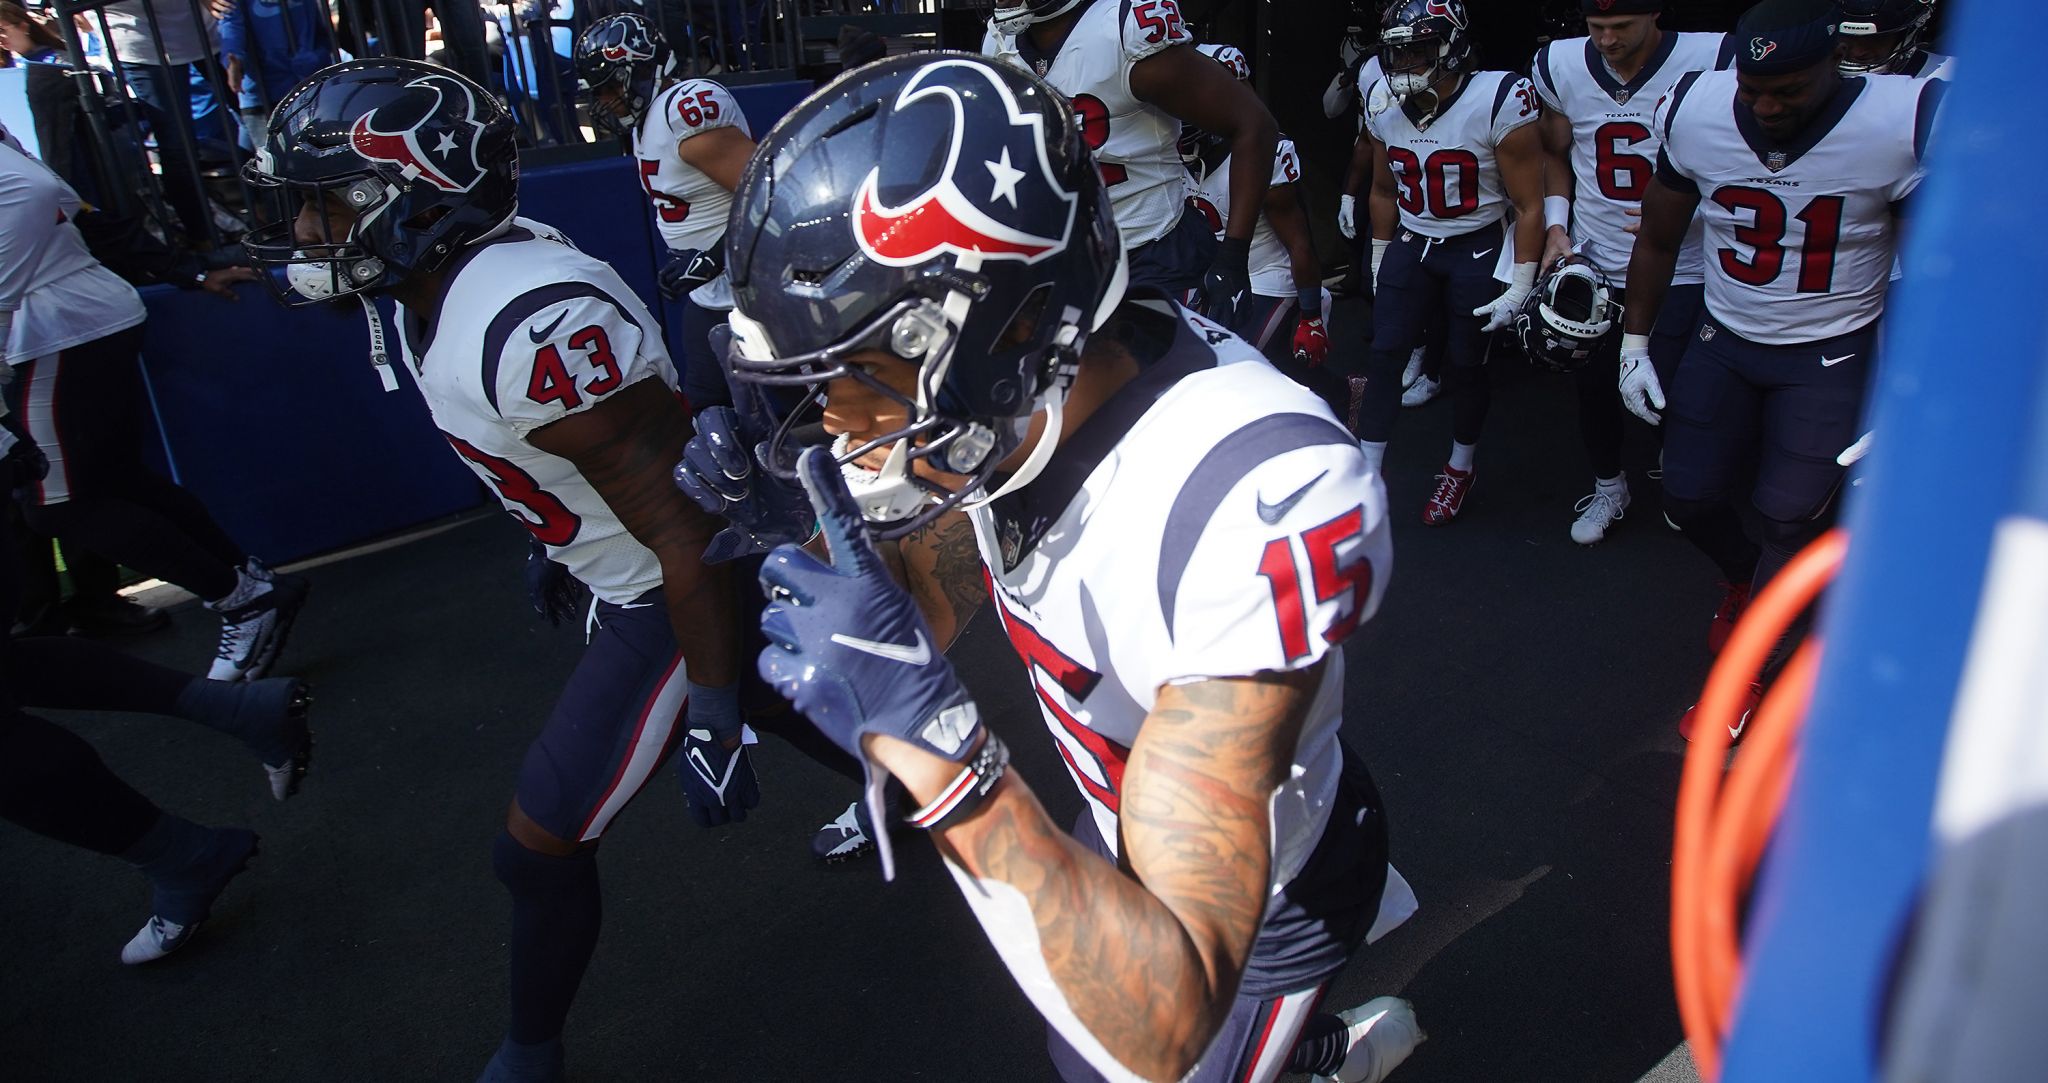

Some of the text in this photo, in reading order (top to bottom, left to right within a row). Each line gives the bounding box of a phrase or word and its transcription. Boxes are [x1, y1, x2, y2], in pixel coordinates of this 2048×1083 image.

[1133, 1, 1184, 43] 52
[677, 90, 730, 127] 65
[1515, 84, 1544, 117] 30
[1387, 145, 1480, 219] 30
[1594, 121, 1654, 202] 6
[1746, 176, 1800, 188] TEXANS
[1710, 184, 1846, 293] 31
[1553, 319, 1599, 335] TEXANS
[526, 324, 623, 411] 43
[1255, 502, 1374, 667] 15
